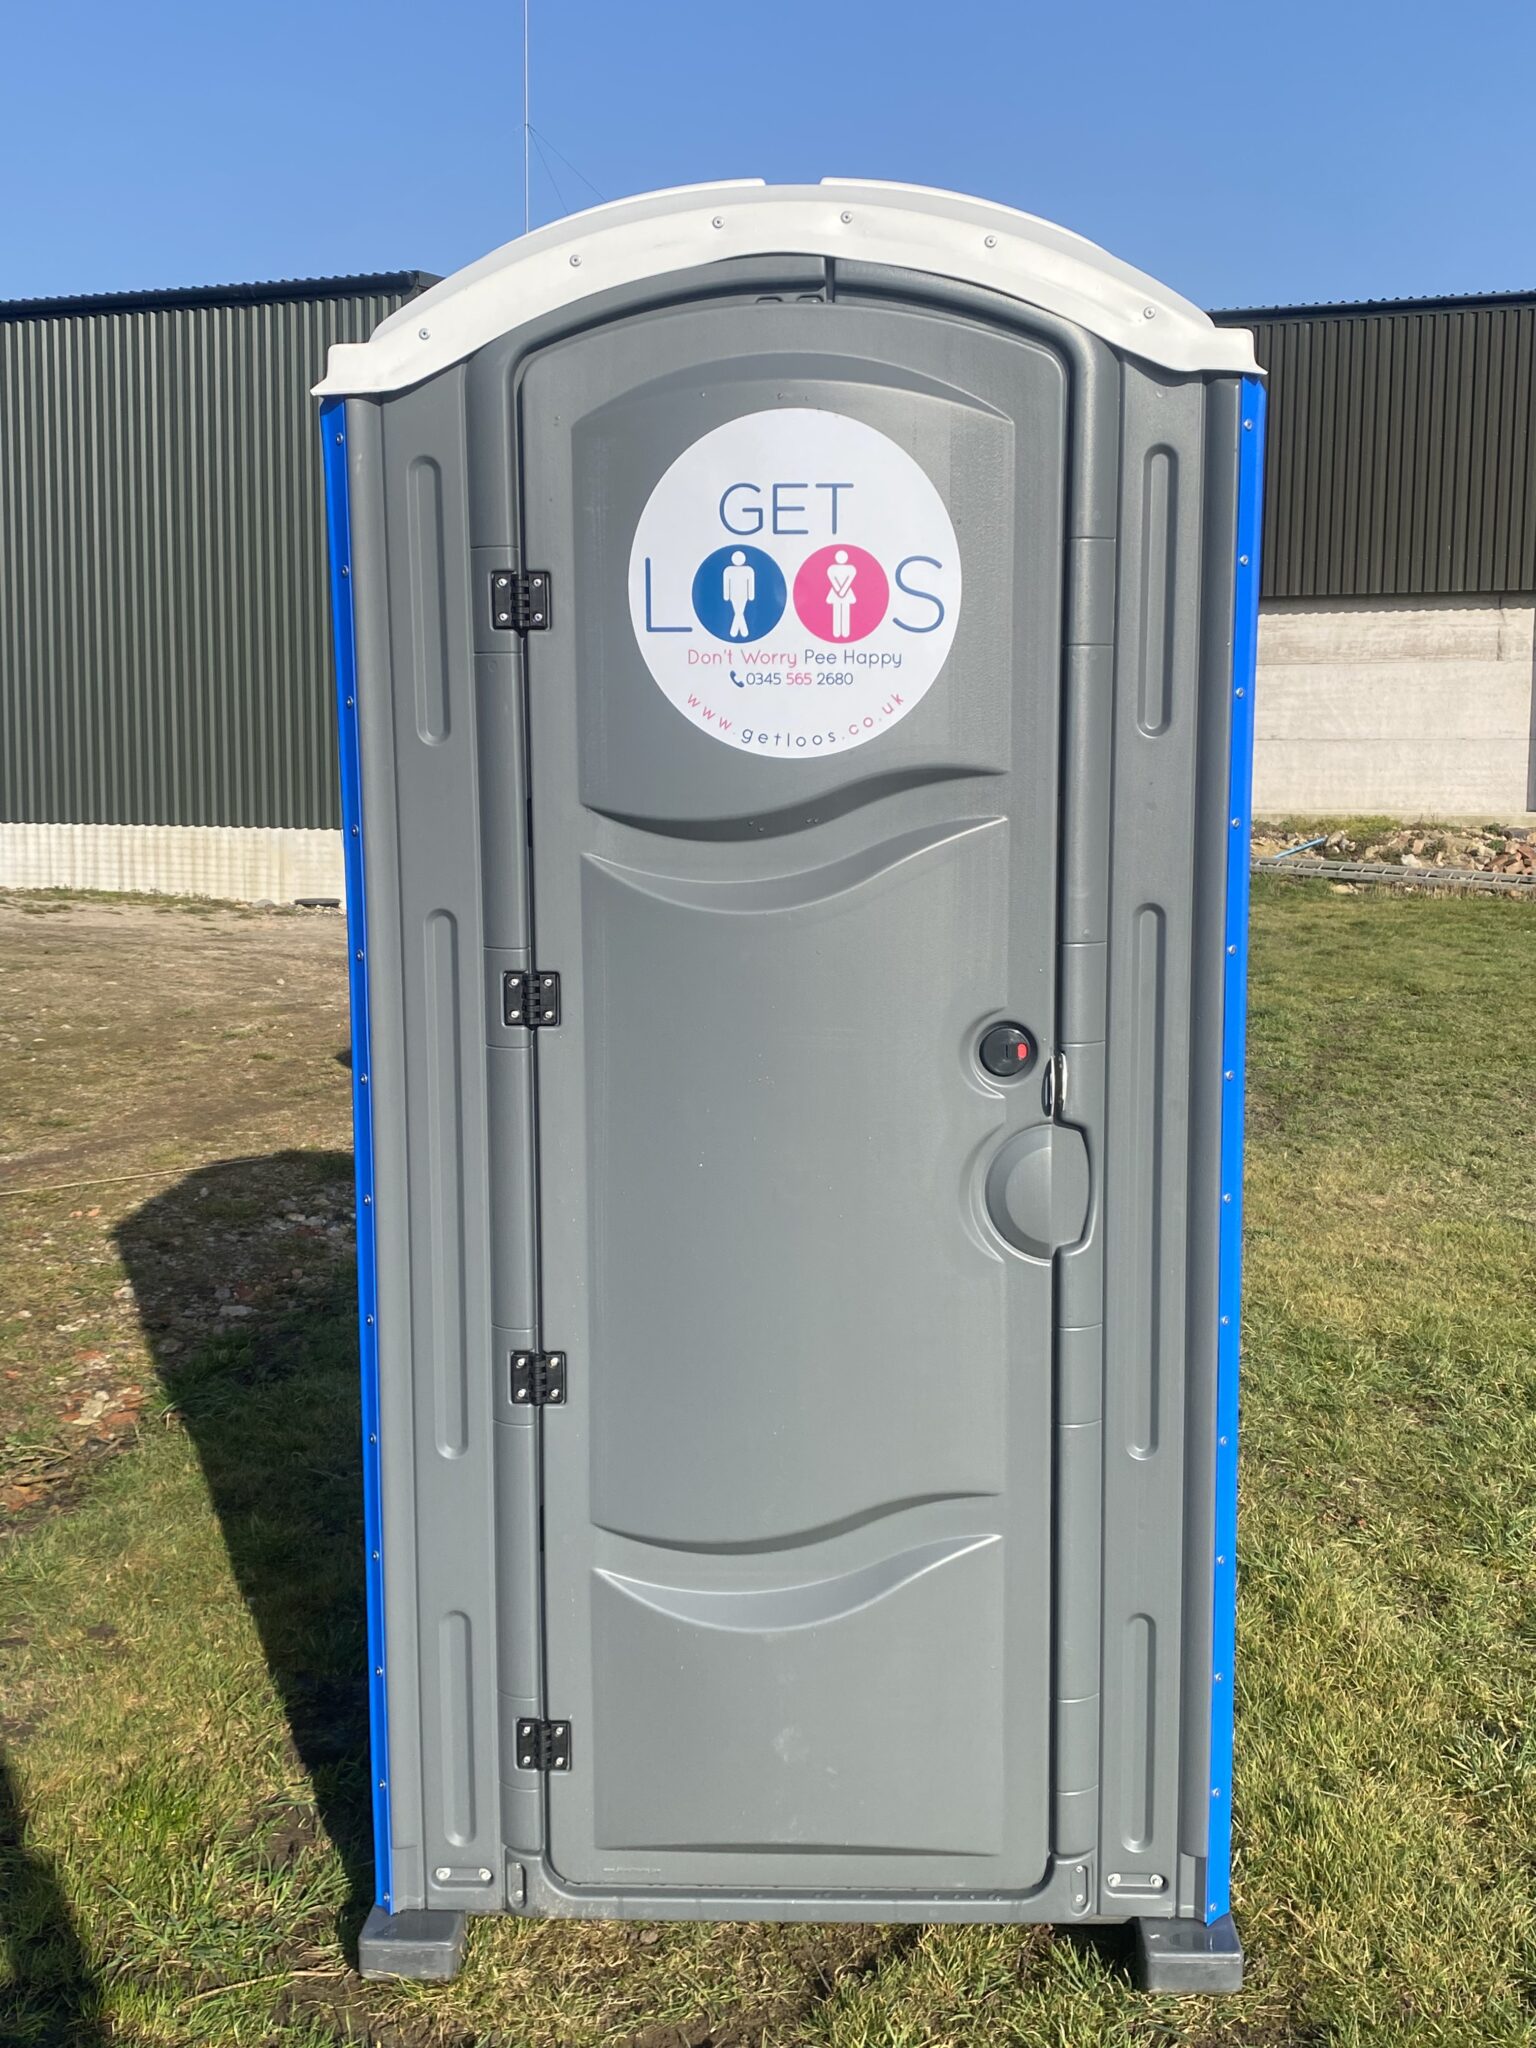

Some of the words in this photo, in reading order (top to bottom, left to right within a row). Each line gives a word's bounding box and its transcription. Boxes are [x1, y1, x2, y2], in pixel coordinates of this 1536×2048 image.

[719, 482, 854, 536] GET
[645, 543, 945, 644] LOOS
[687, 649, 733, 665] Don't
[741, 650, 798, 669] Worry
[804, 649, 837, 664] Pee
[843, 649, 903, 669] Happy
[746, 672, 782, 686] 0345
[786, 672, 812, 686] 565
[816, 672, 854, 686] 2680
[687, 692, 905, 748] www.getloos.co.uk
